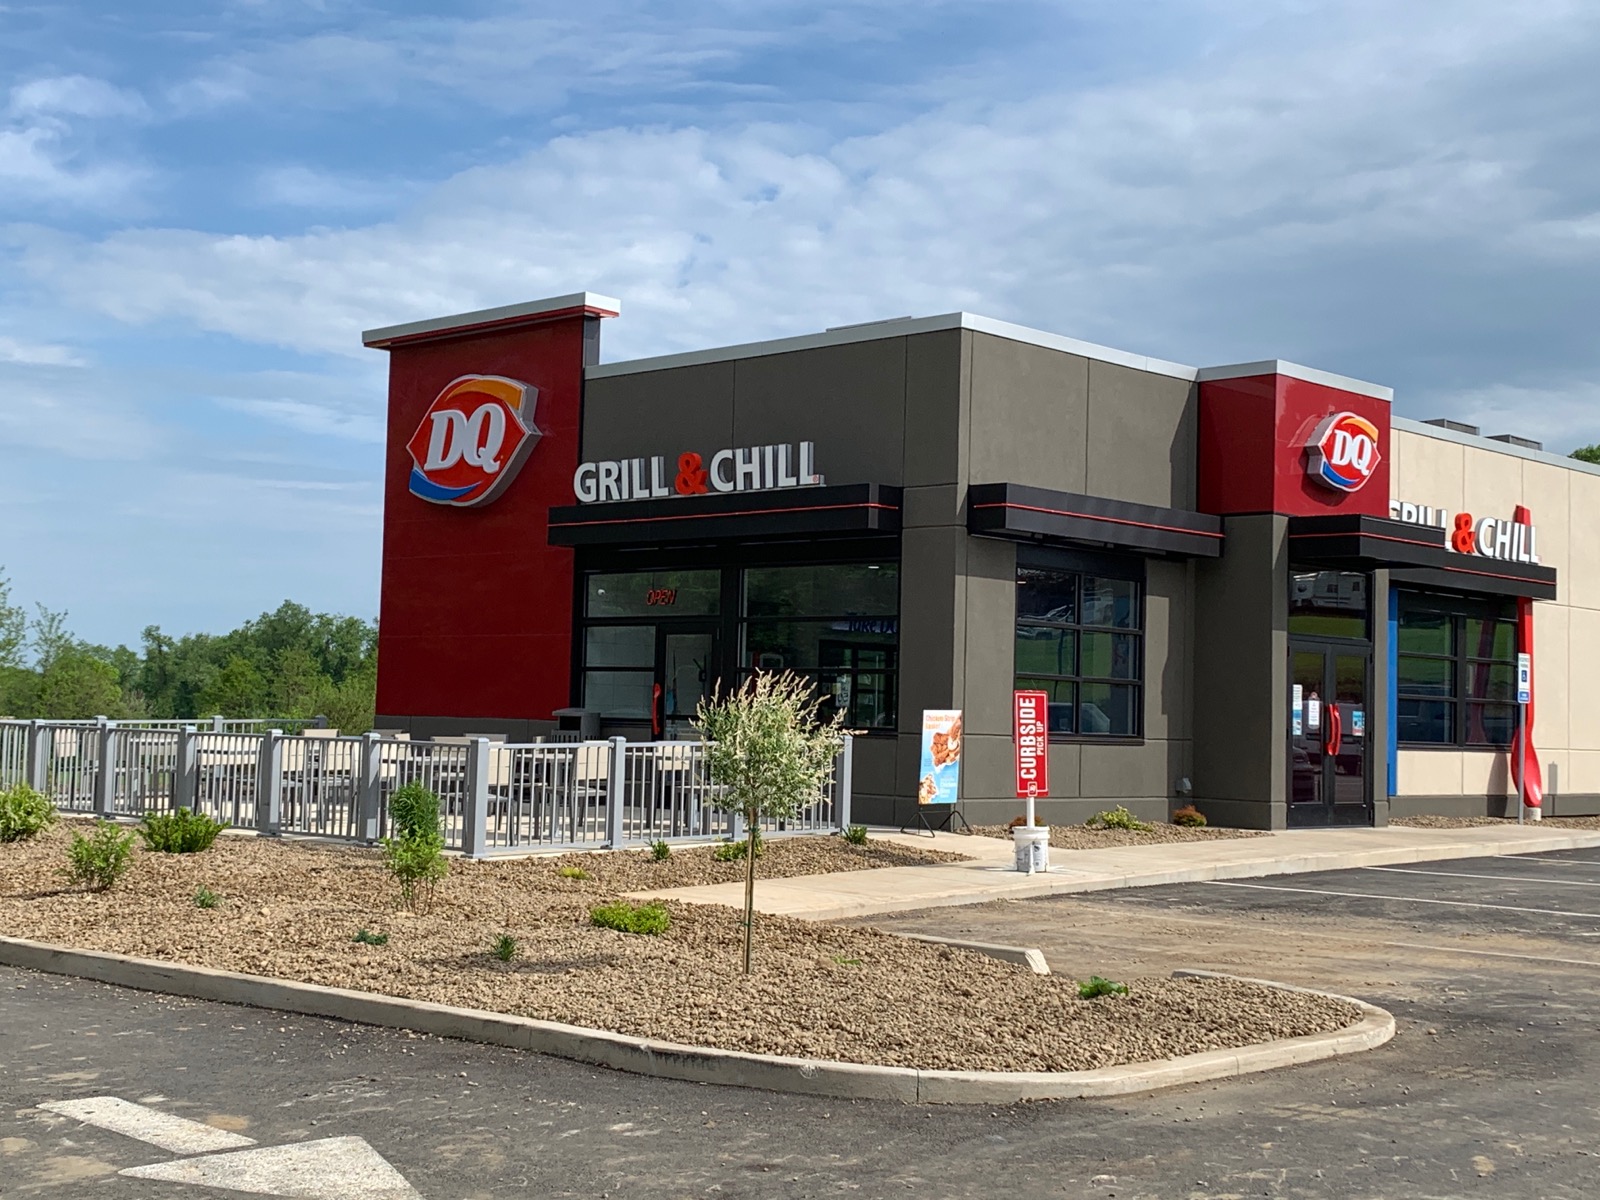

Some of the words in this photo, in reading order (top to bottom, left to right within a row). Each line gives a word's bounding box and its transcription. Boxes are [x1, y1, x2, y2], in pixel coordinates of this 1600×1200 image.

[424, 403, 506, 474] DQ
[1331, 429, 1372, 476] DQ
[573, 456, 668, 502] GRILL
[674, 452, 708, 495] &
[710, 441, 819, 492] CHILL
[1452, 513, 1475, 553] &
[1476, 517, 1540, 563] CHILL
[646, 589, 676, 605] OPEN
[1019, 697, 1037, 780] CURBSIDE
[1036, 720, 1044, 733] UP
[1036, 735, 1044, 756] PICK
